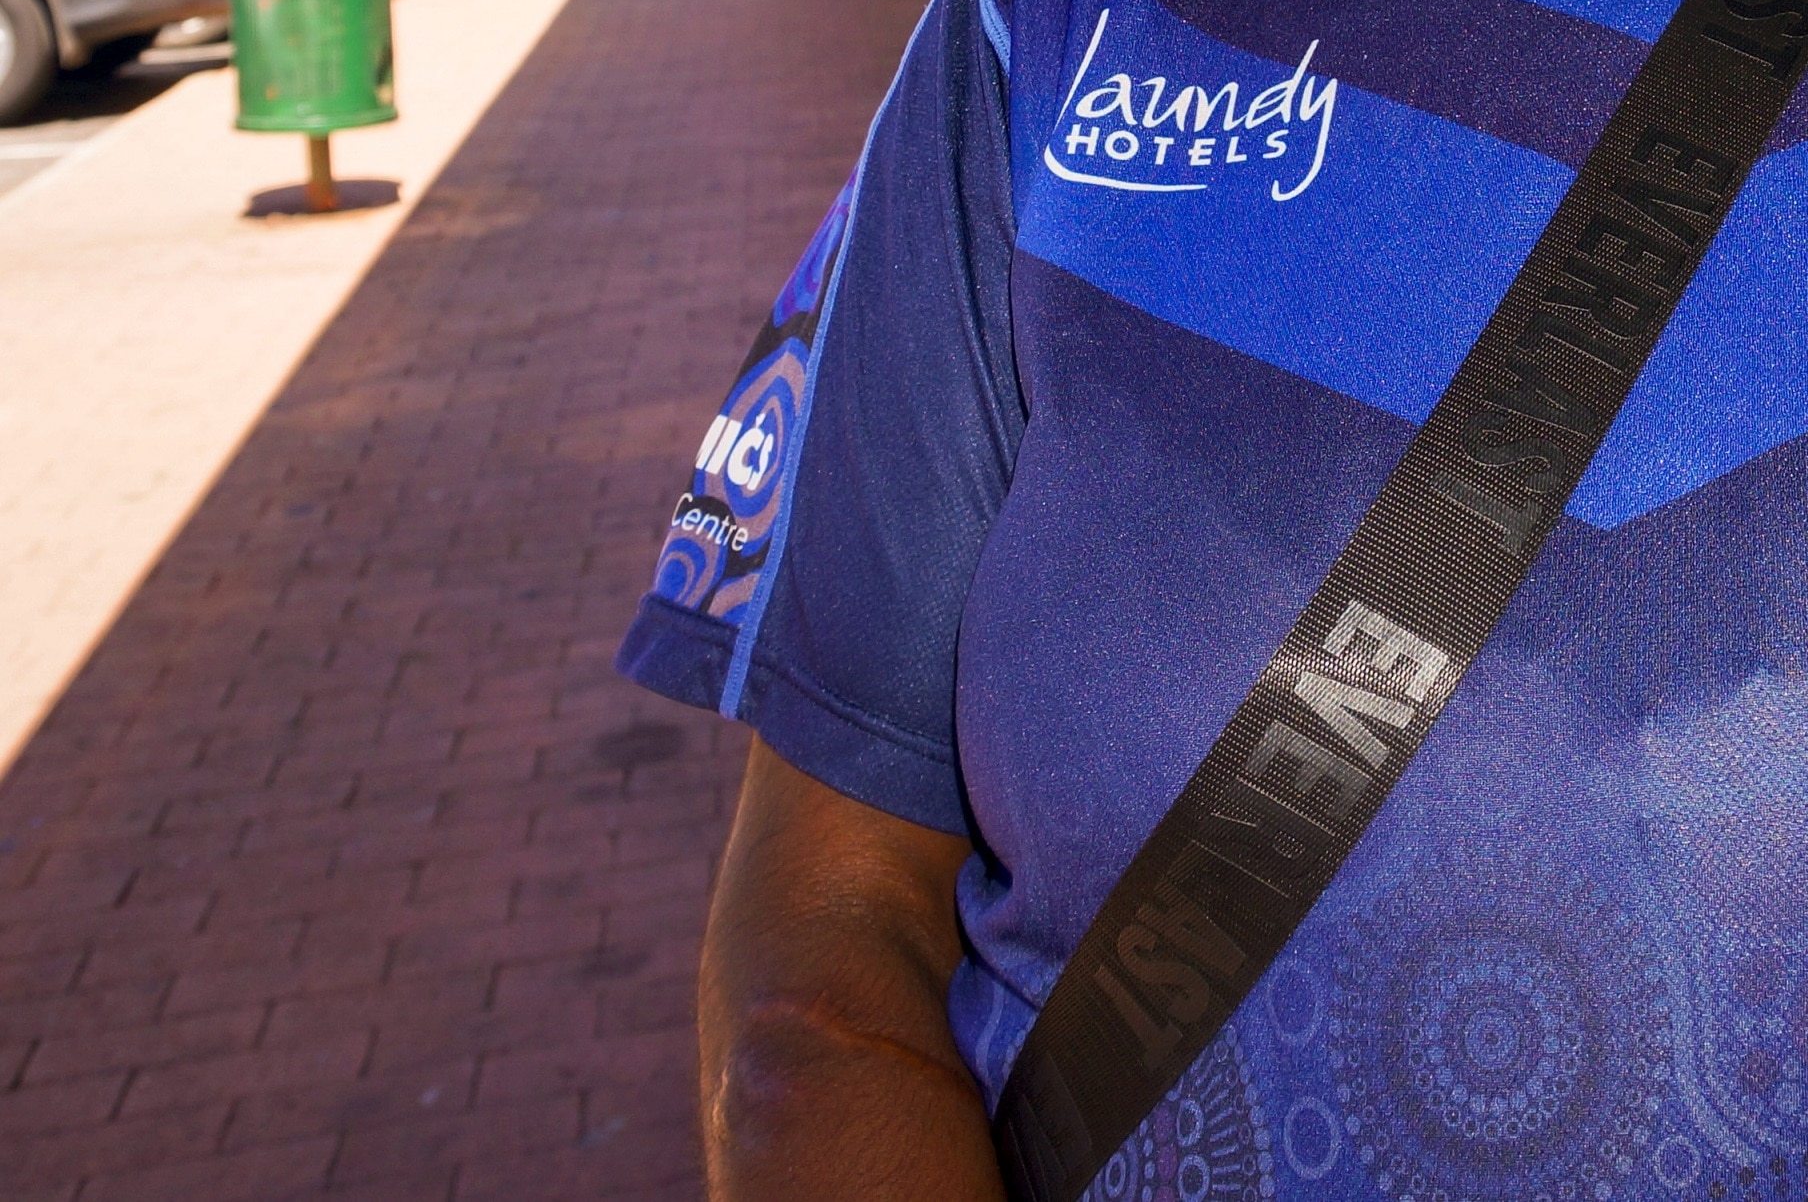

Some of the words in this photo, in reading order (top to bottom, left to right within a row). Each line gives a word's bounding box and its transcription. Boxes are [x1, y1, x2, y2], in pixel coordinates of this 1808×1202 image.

[1065, 123, 1289, 166] HOTELS
[1432, 128, 1747, 558] EVERLAST
[671, 492, 748, 552] Centre
[1092, 598, 1452, 1076] EVERLAST
